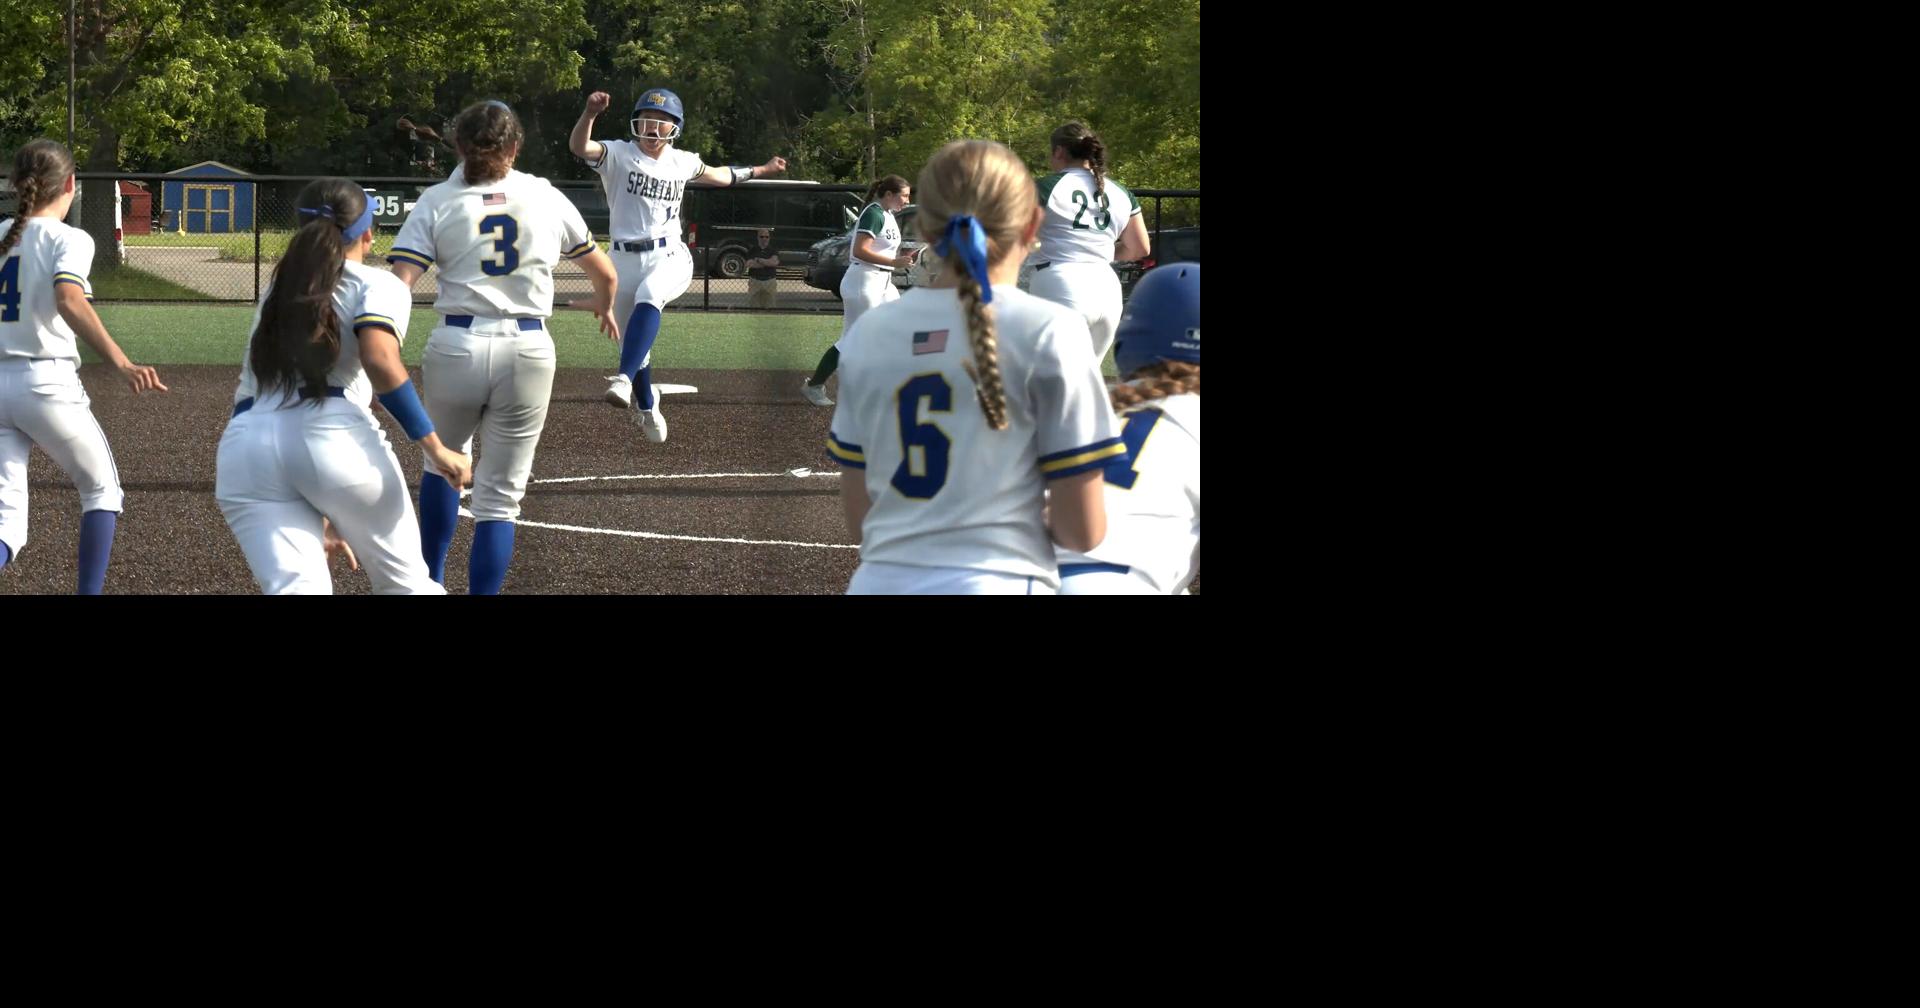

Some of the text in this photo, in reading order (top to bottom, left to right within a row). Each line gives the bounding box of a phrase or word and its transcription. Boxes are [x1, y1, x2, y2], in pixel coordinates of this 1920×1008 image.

[372, 195, 400, 216] 95
[1071, 189, 1111, 231] 23
[478, 212, 520, 277] 3
[889, 372, 953, 500] 6
